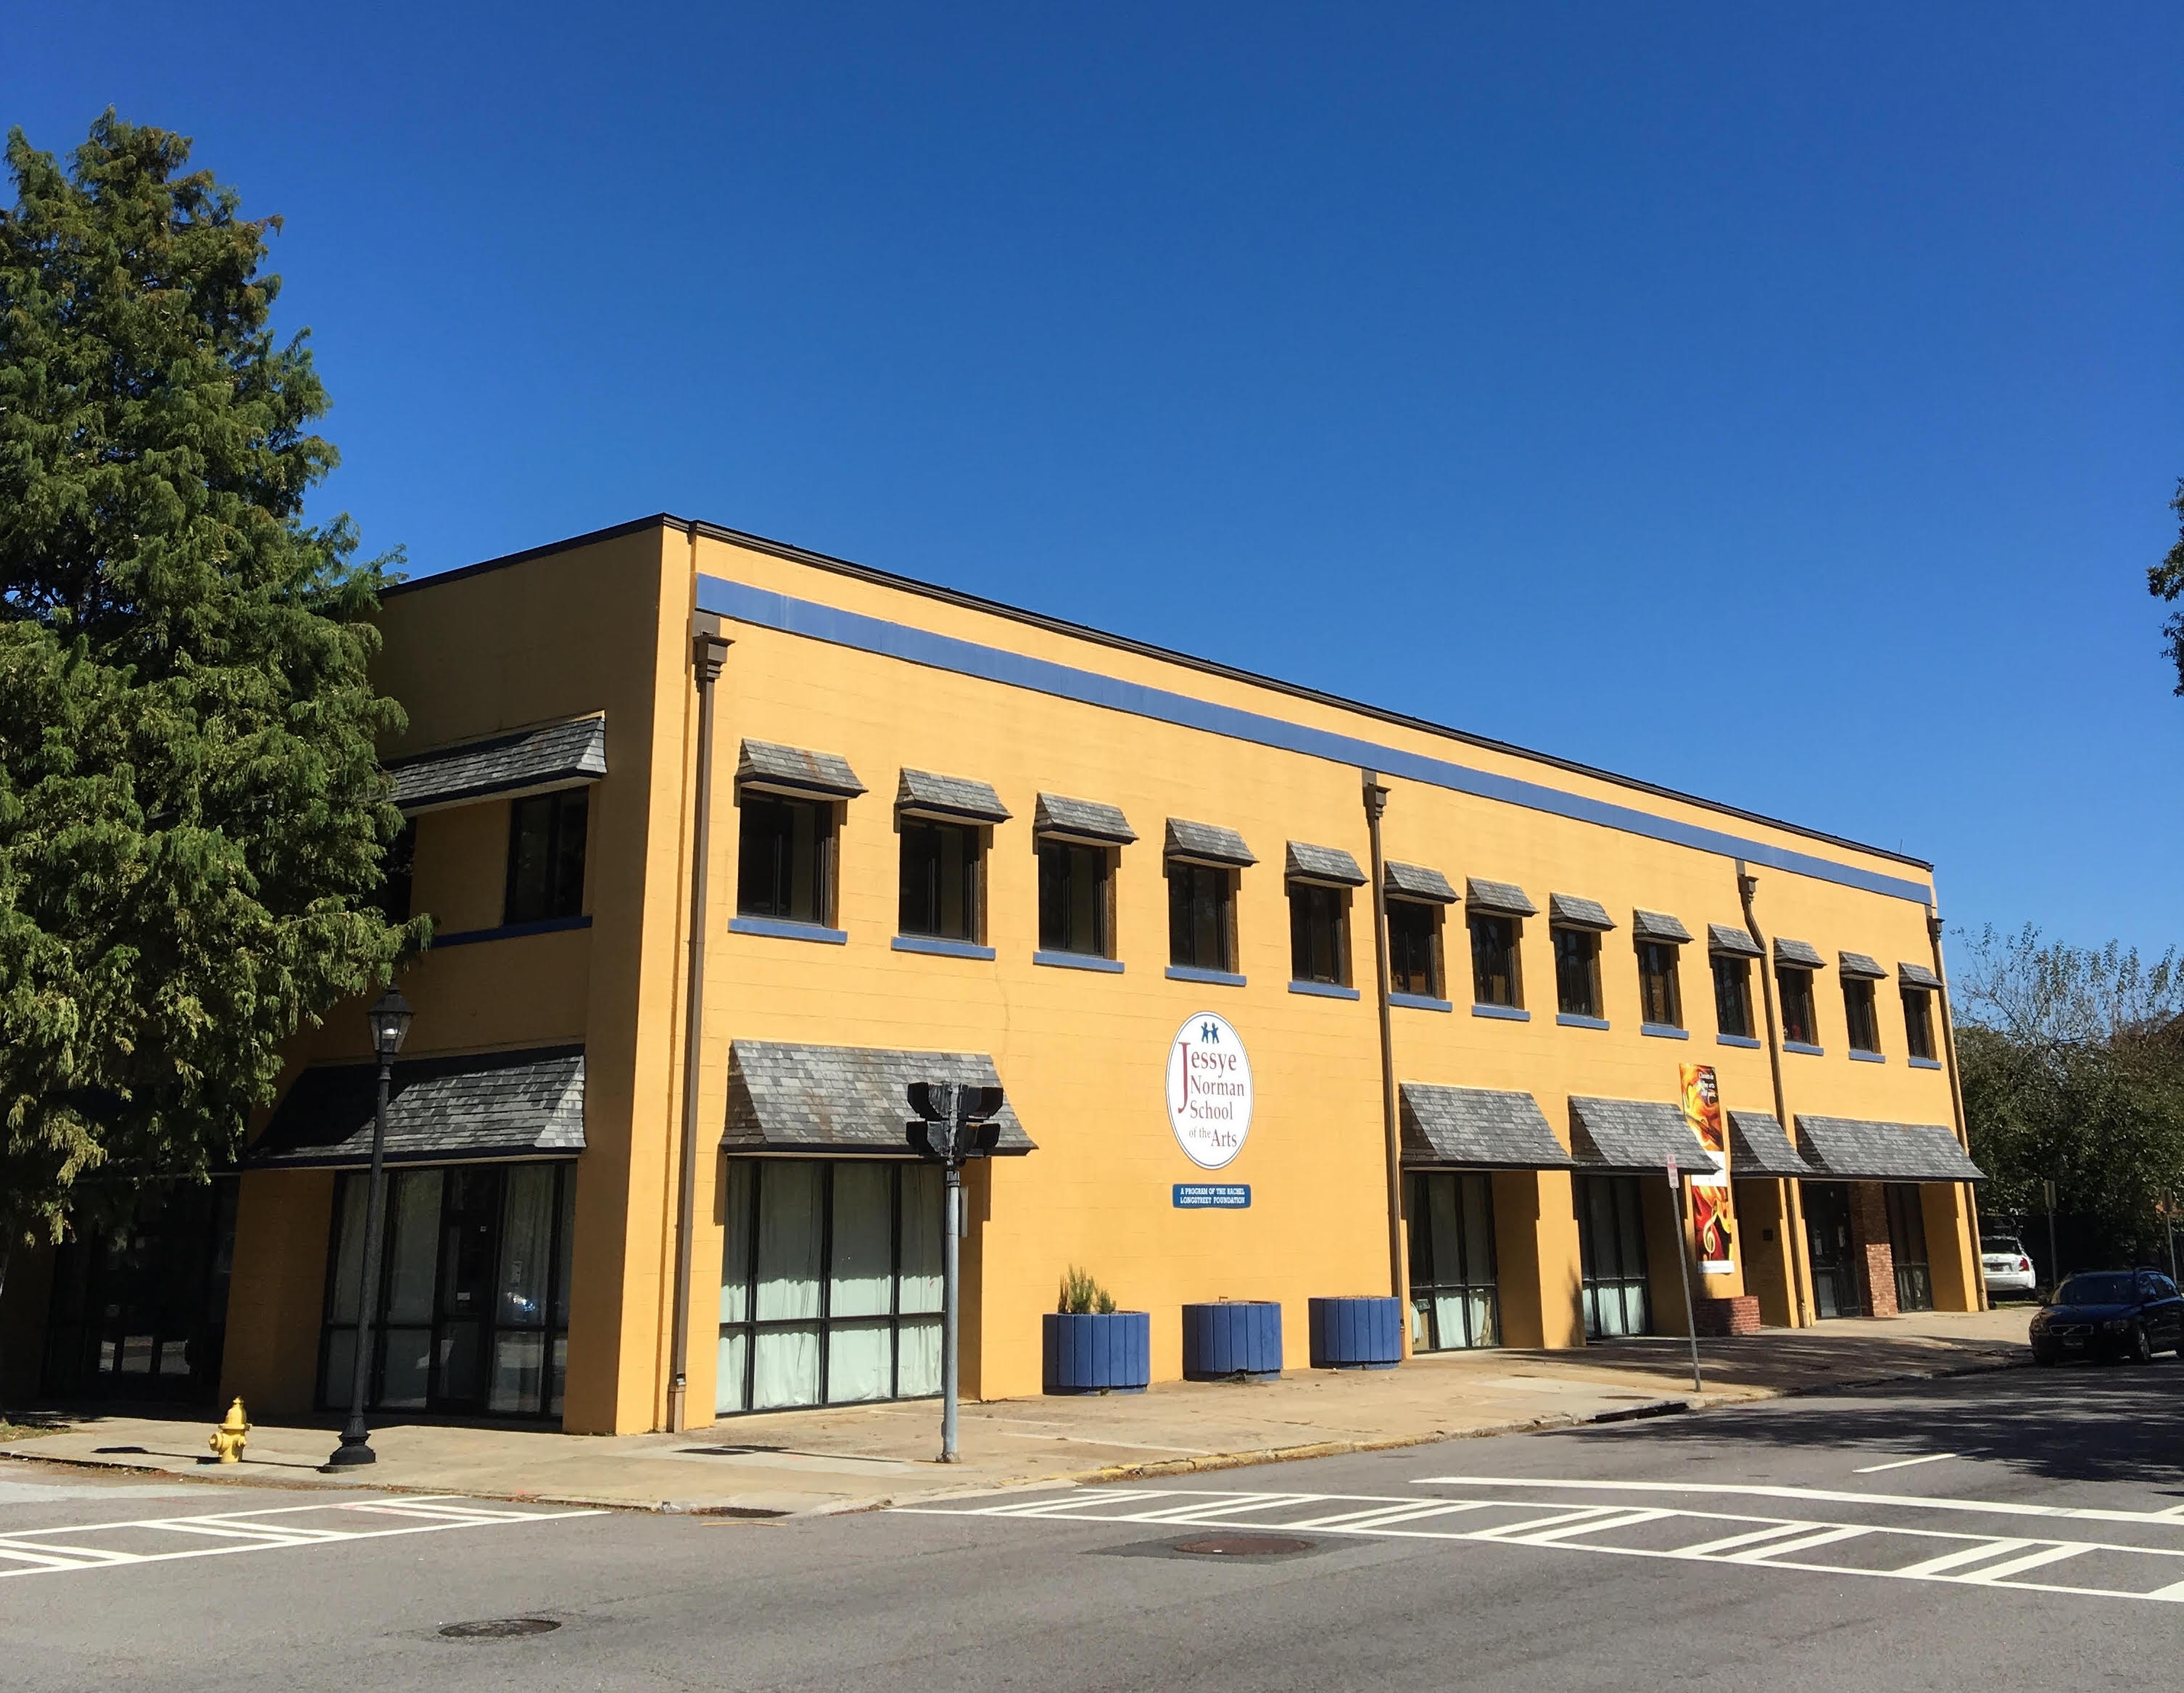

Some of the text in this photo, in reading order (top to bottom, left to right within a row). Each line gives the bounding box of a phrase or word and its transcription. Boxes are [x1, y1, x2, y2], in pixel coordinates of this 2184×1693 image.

[1178, 1042, 1237, 1114] Jessye
[1191, 1075, 1244, 1096] Norman
[1190, 1100, 1233, 1119] School
[1189, 1126, 1237, 1147] of the Arts
